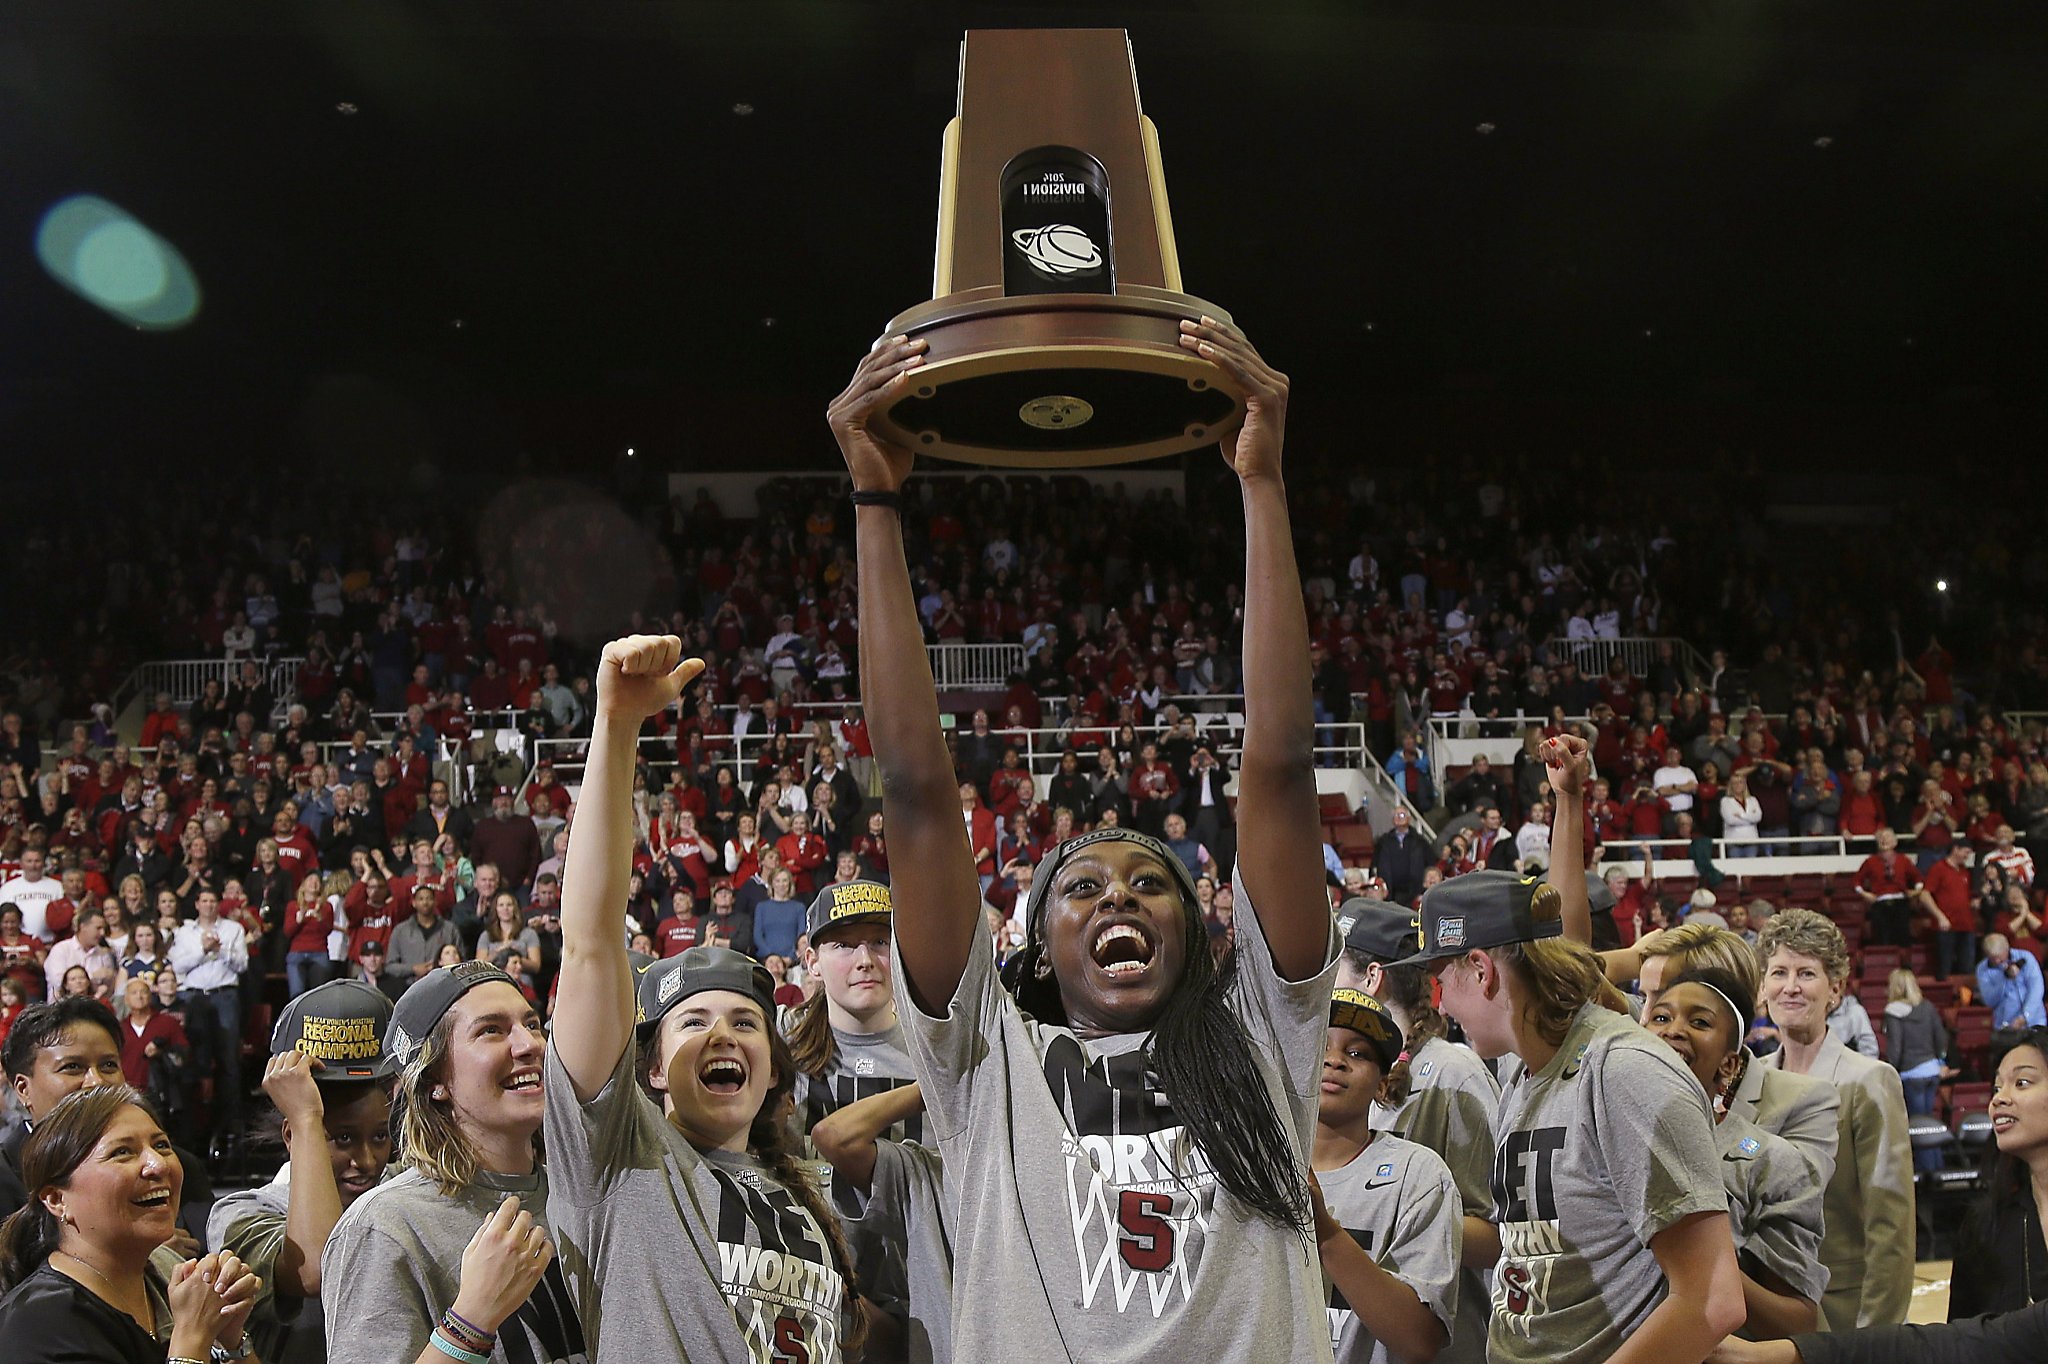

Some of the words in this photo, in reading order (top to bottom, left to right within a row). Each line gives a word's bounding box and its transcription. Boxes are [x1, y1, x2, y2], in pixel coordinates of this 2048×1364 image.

[302, 1022, 376, 1043] REGIONAL
[294, 1038, 380, 1060] CHAMPIONS
[1117, 1189, 1177, 1273] S
[717, 1241, 843, 1312] WORTHY
[720, 1283, 744, 1296] 2014
